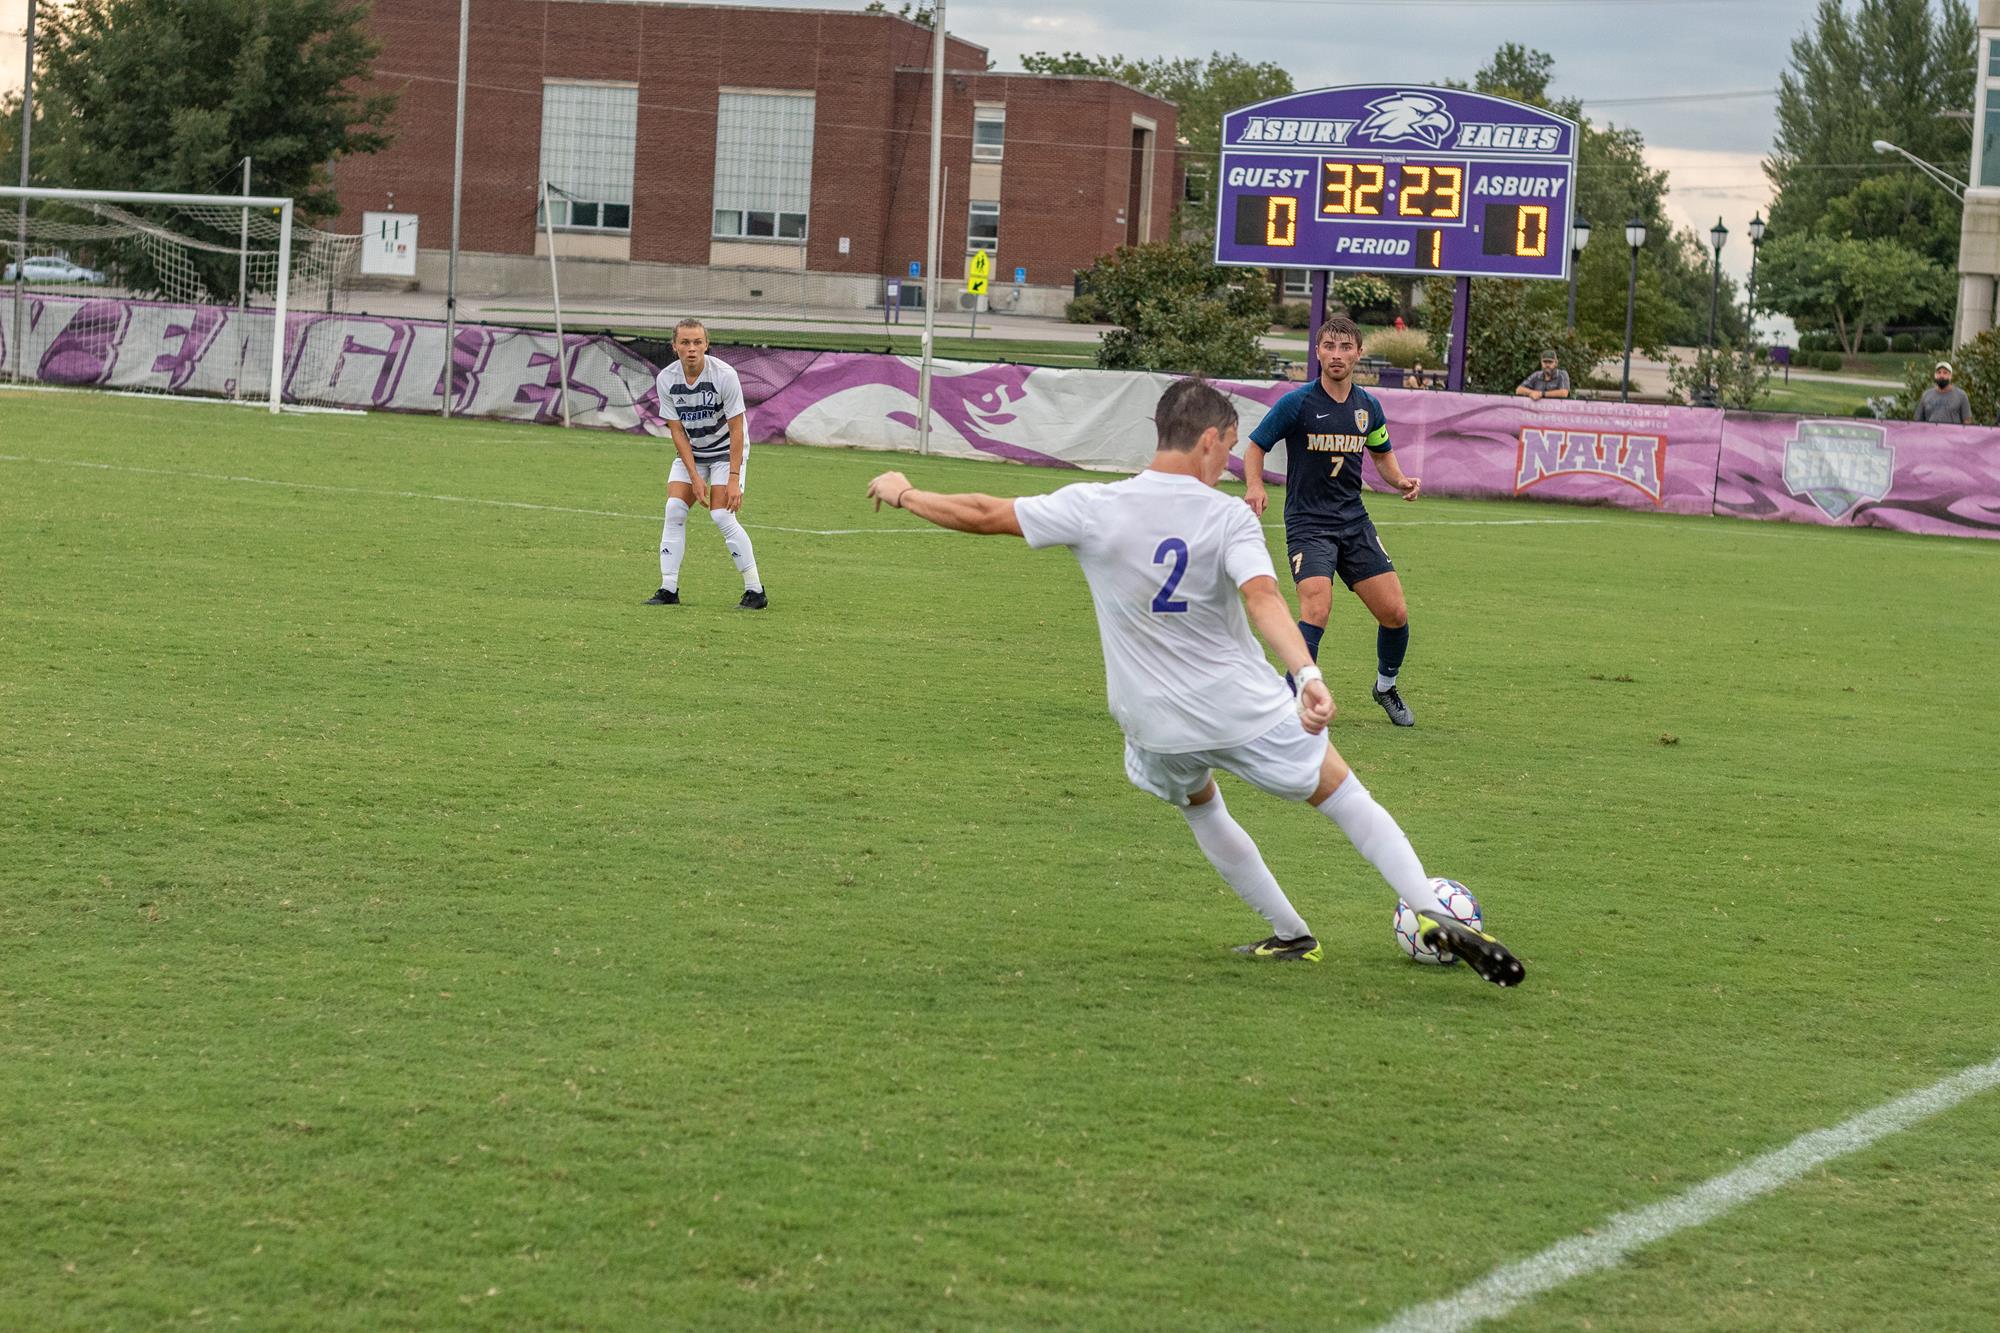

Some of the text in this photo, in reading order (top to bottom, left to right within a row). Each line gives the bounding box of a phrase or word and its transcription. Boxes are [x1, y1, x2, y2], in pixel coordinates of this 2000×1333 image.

[1243, 118, 1561, 151] ASBURY EAGLES
[1228, 167, 1309, 188] GUEST
[1322, 163, 1462, 218] 32:23
[1473, 175, 1565, 198] ASBURY
[1266, 196, 1297, 247] 0
[1516, 205, 1548, 257] 0
[1336, 237, 1411, 256] PERIOD
[1431, 229, 1442, 268] 1
[702, 391, 714, 407] 12
[680, 409, 714, 421] ASBURY
[1329, 456, 1345, 478] 7
[1517, 428, 1662, 500] NAIA
[1152, 537, 1189, 614] 2
[1291, 552, 1304, 575] 7
